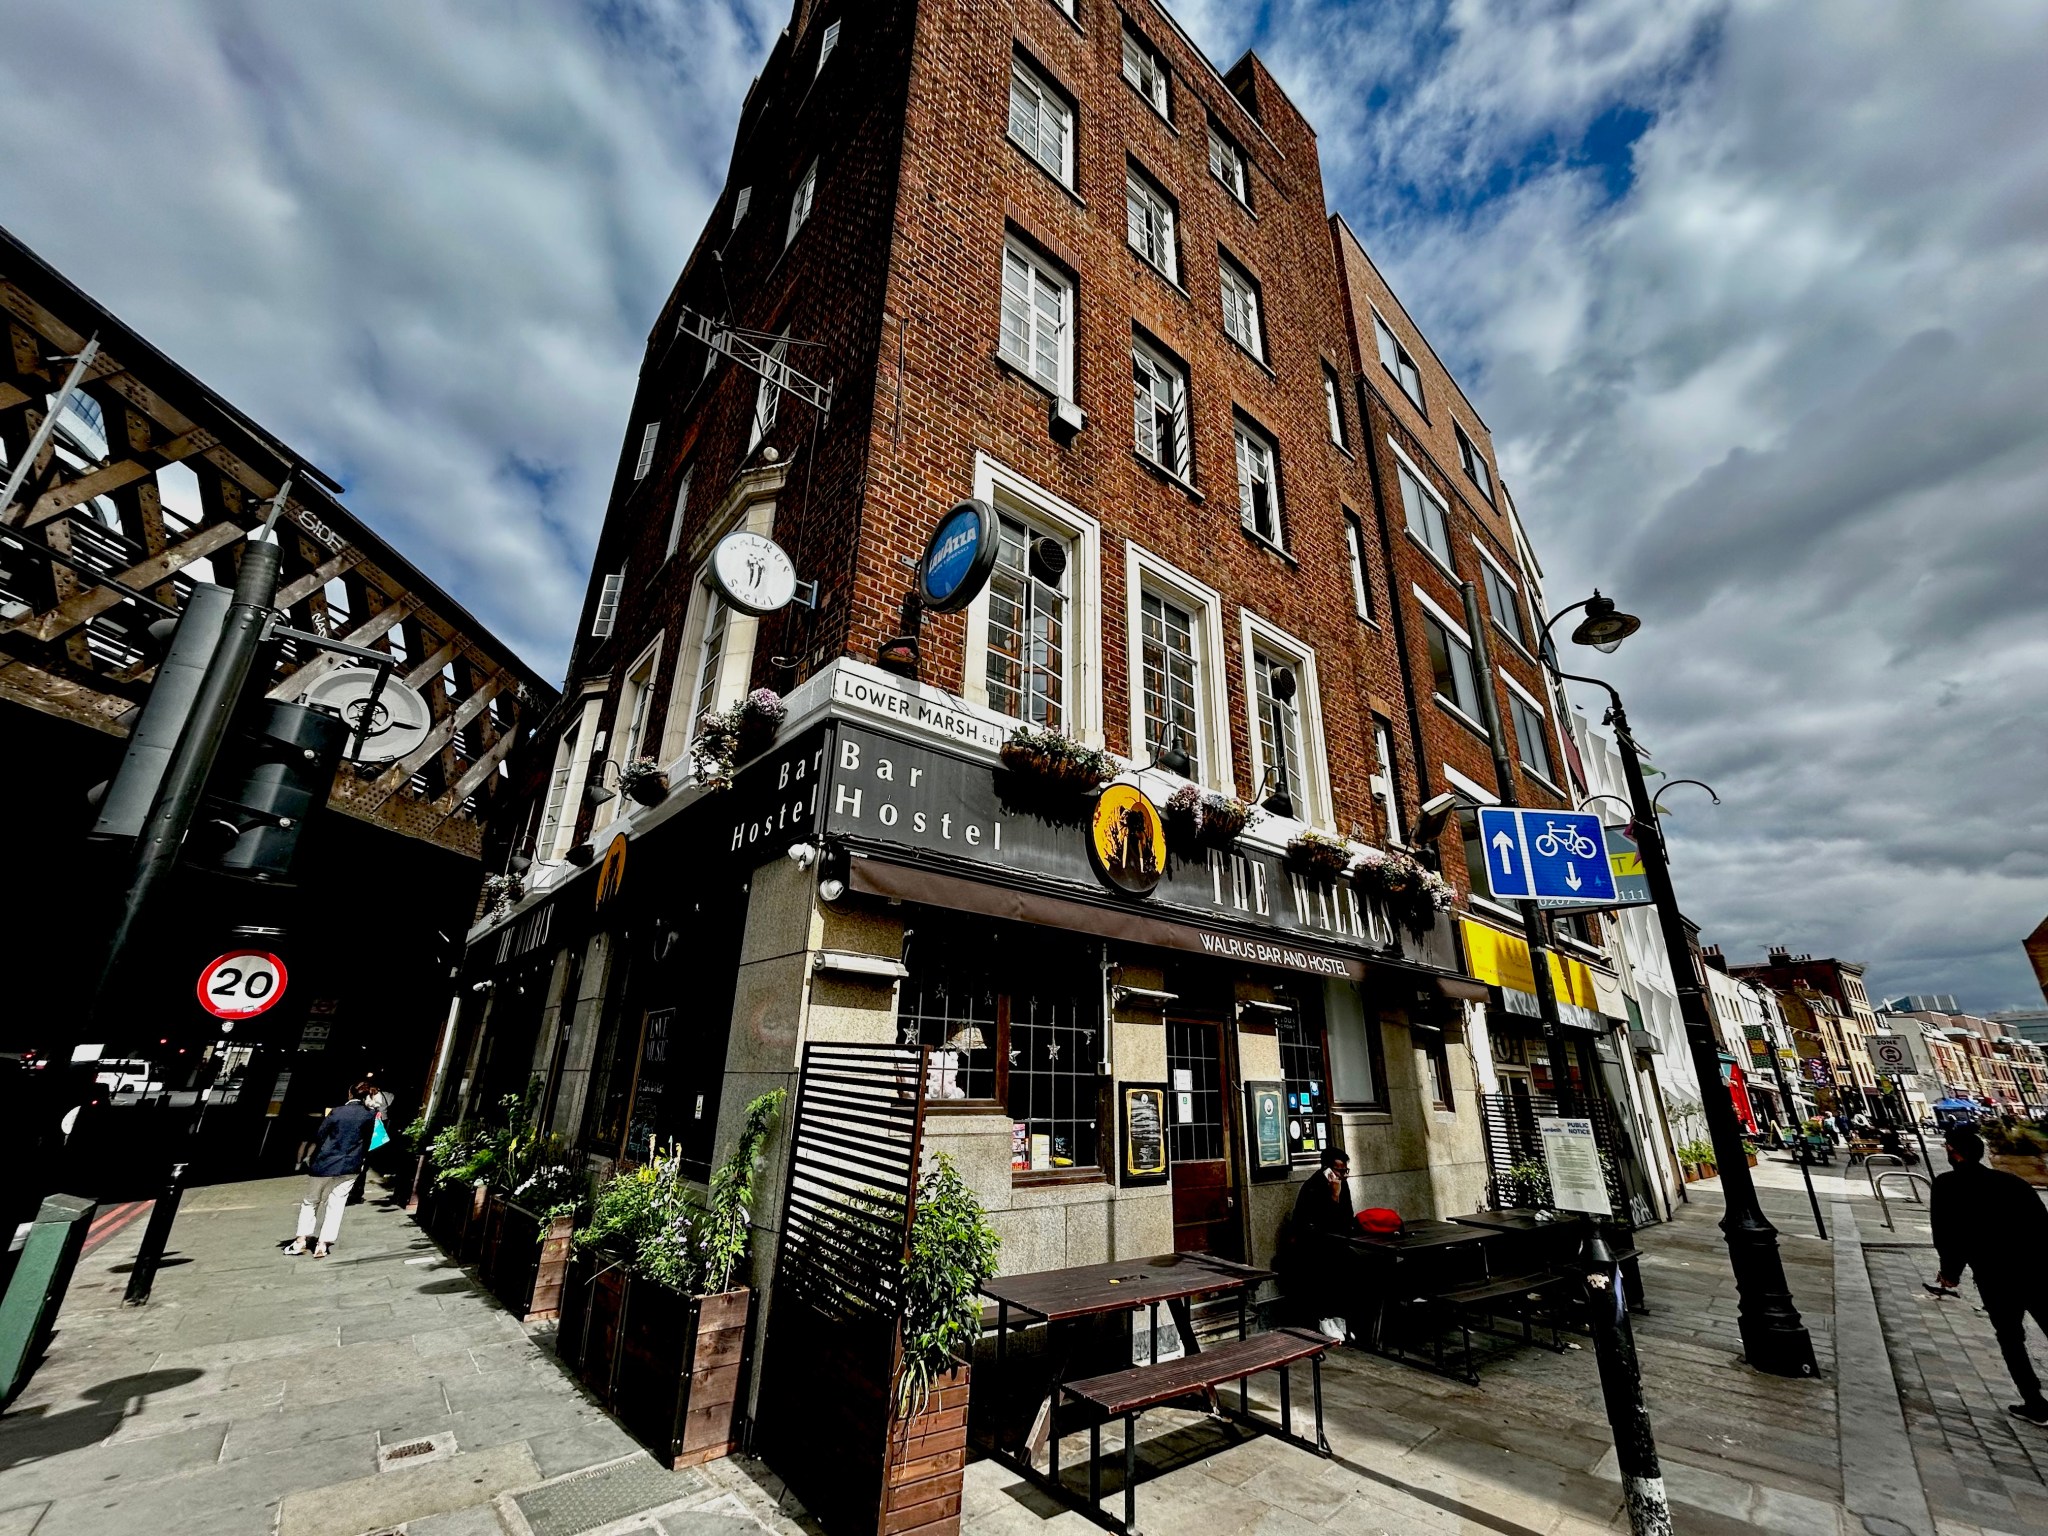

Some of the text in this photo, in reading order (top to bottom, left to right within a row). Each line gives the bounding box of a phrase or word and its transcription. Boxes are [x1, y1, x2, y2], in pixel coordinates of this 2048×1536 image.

[844, 680, 910, 717] LOWER
[918, 705, 978, 740] MARSH
[778, 748, 823, 790] Bar
[839, 739, 923, 788] Bar
[731, 783, 818, 851] Hostel
[834, 784, 1001, 850] Hostel
[1207, 847, 1395, 946] THE WALRUS
[1200, 933, 1350, 976] WALRUS BAR AND HOSTEL
[211, 967, 274, 999] 20
